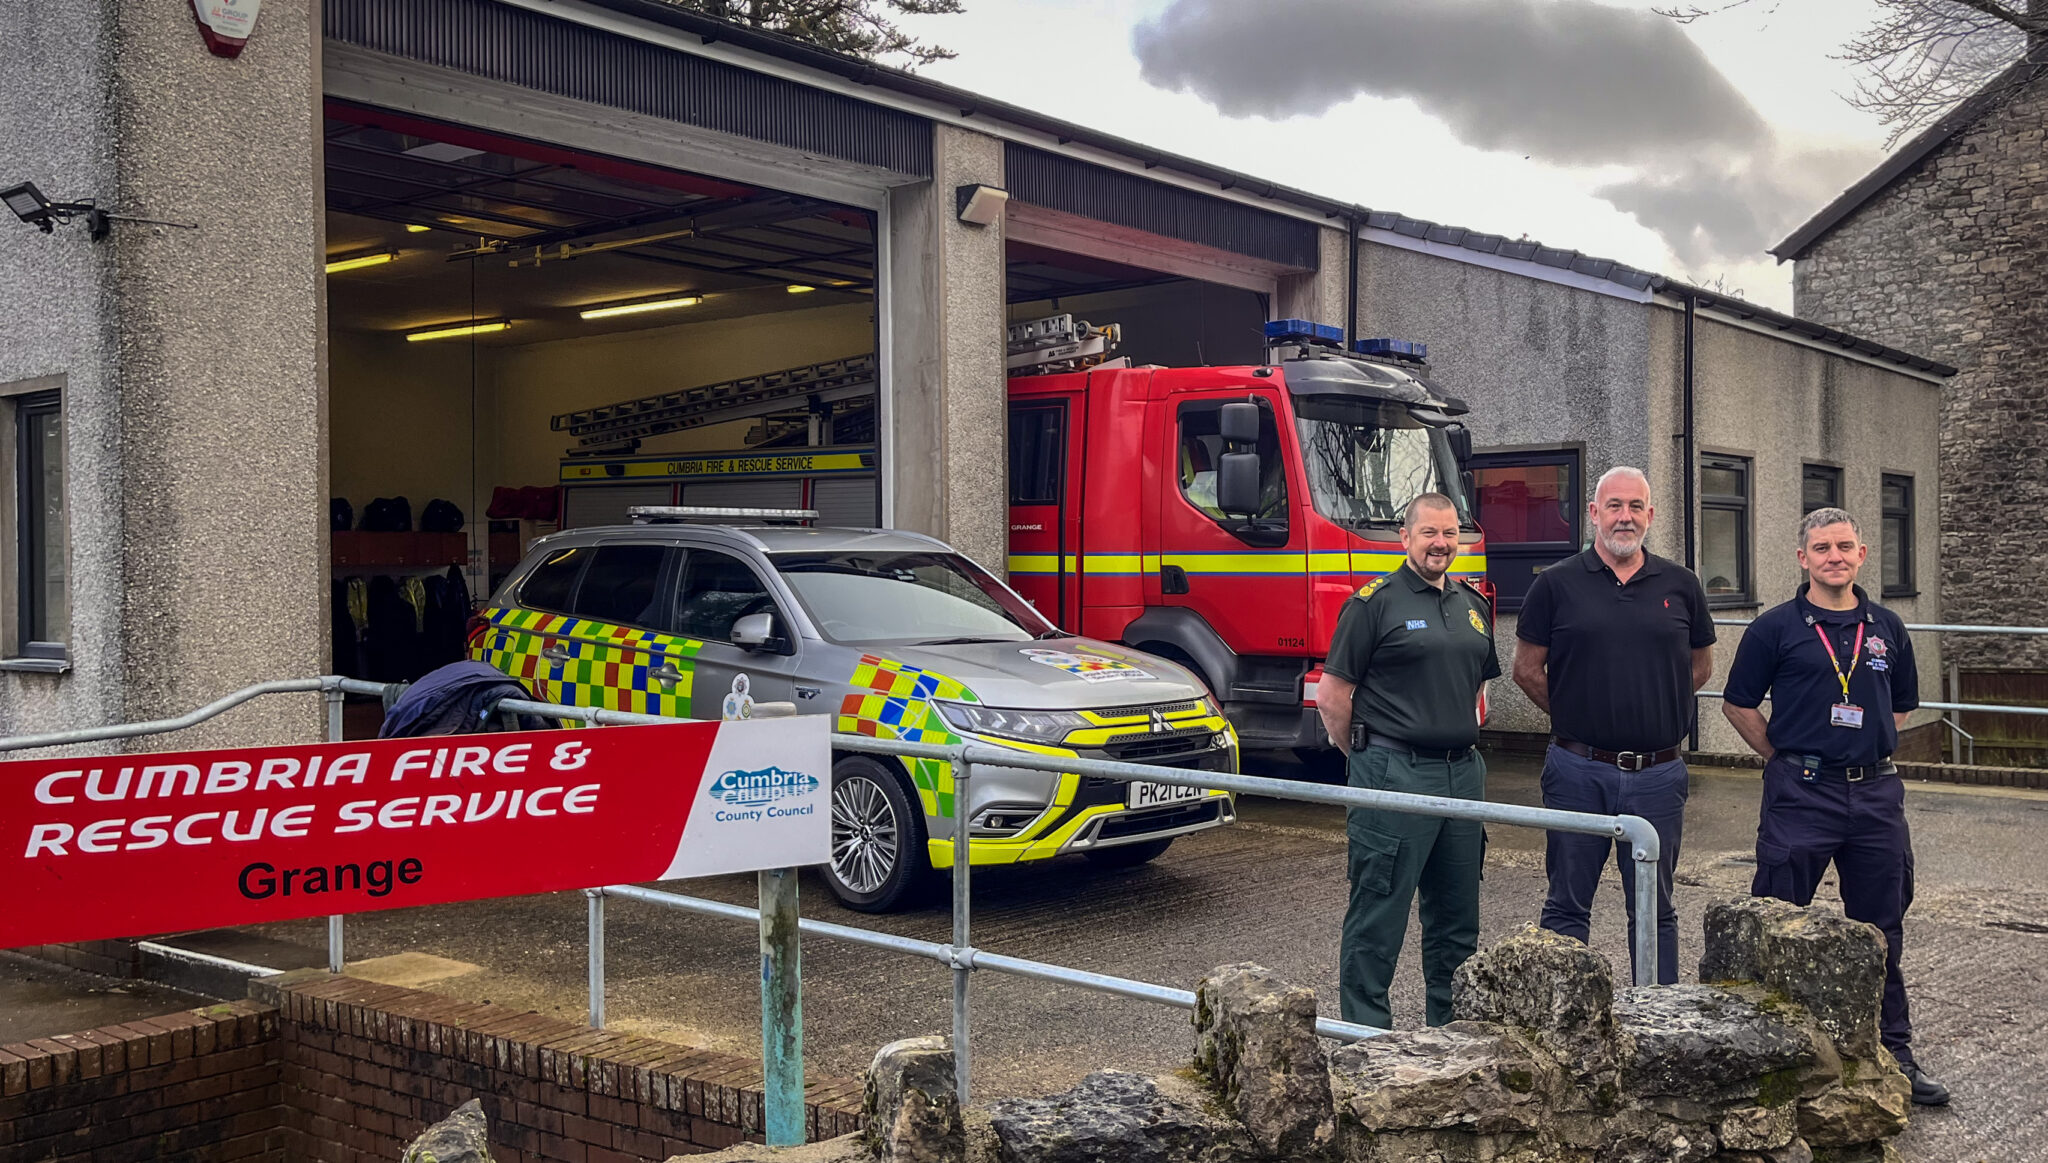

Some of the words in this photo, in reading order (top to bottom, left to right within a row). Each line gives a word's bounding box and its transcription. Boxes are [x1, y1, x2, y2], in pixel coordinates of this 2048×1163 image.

[667, 461, 703, 474] CUMBRIA
[706, 460, 724, 472] FIRE
[728, 460, 735, 472] &
[738, 458, 772, 472] RESCUE
[775, 456, 813, 470] SERVICE
[1407, 620, 1427, 630] NHS
[1277, 637, 1305, 647] 01124
[34, 752, 372, 805] CUMBRIA
[390, 743, 533, 781] FIRE
[549, 740, 592, 771] &
[720, 769, 810, 790] Cumbria
[24, 804, 316, 858] RESCUE
[333, 783, 601, 833] SERVICE
[715, 810, 762, 822] County
[767, 803, 813, 817] Council
[238, 857, 423, 899] Grange
